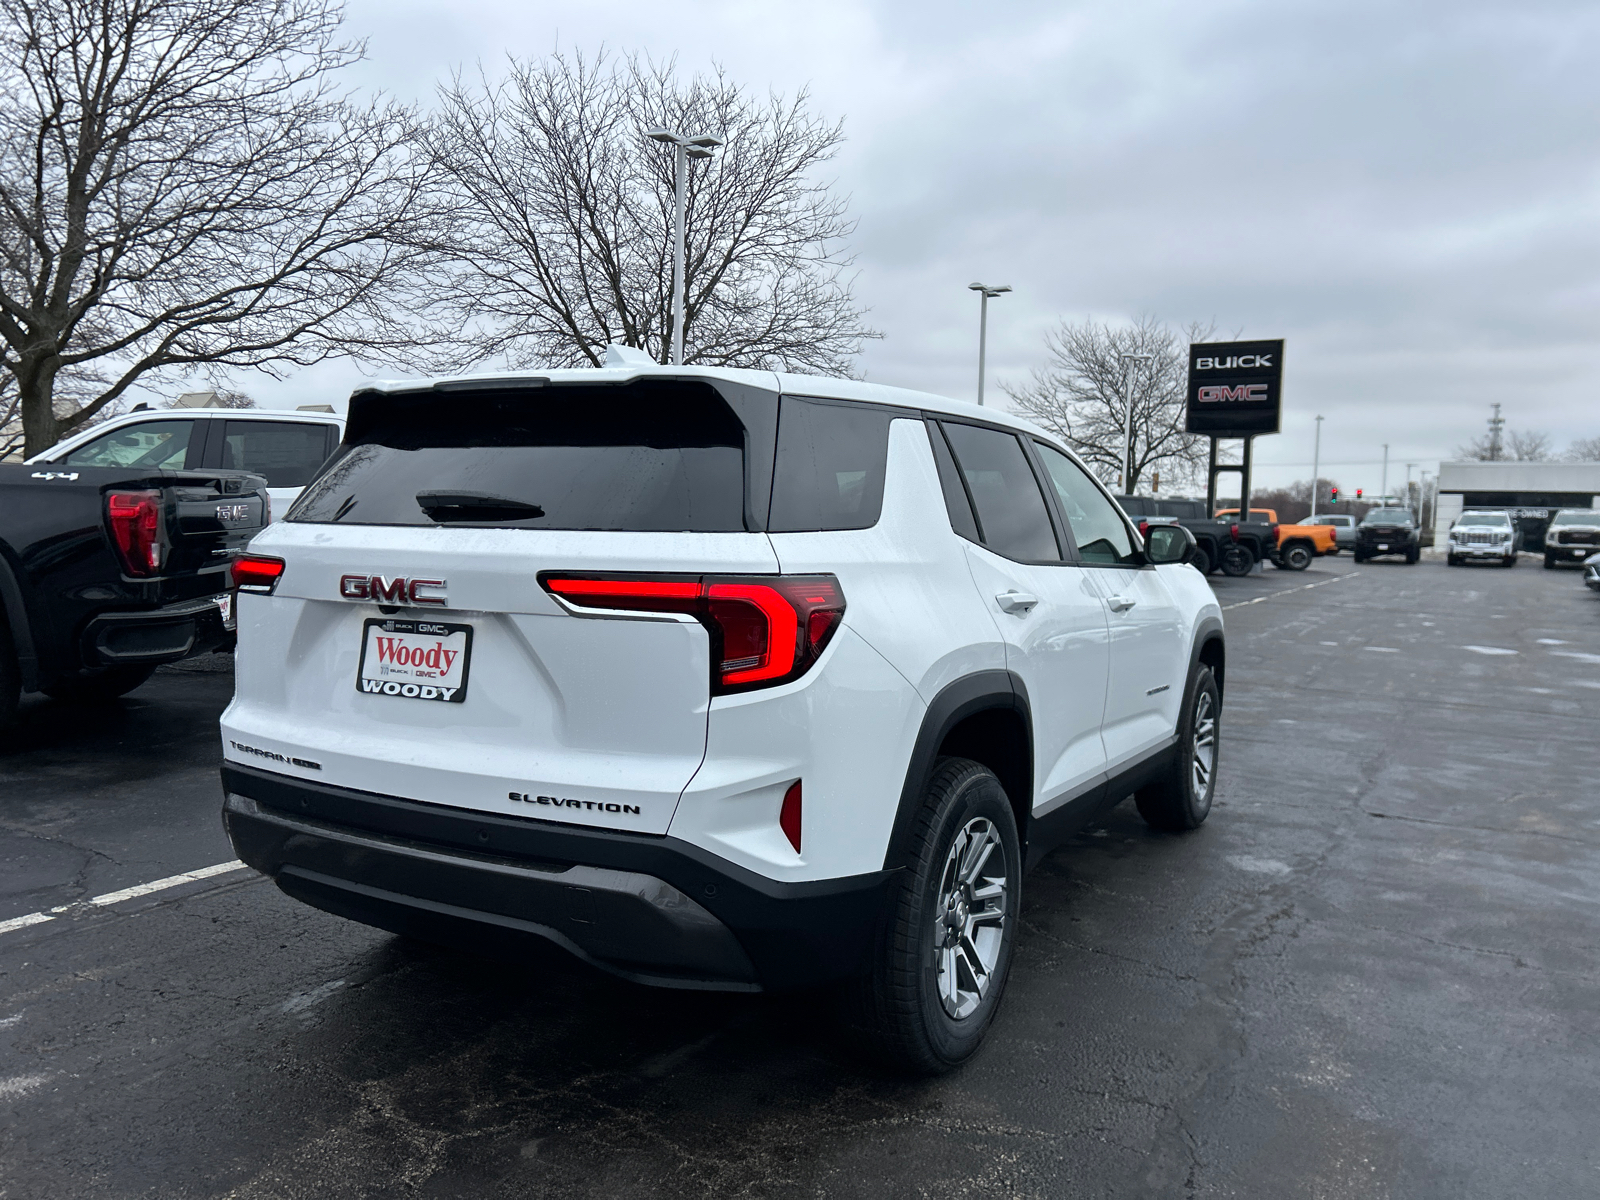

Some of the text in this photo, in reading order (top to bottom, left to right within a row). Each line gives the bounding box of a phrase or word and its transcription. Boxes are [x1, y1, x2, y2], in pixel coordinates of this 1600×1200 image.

[1196, 354, 1273, 370] BUICK
[1198, 384, 1268, 402] GMC
[216, 504, 249, 520] GMC
[340, 572, 448, 607] GMC
[418, 623, 445, 633] GMC
[376, 636, 458, 677] Woody
[415, 670, 437, 678] GMC
[362, 679, 457, 701] WOODY
[230, 740, 291, 765] TERRAIN
[508, 792, 640, 815] ELEVATION
